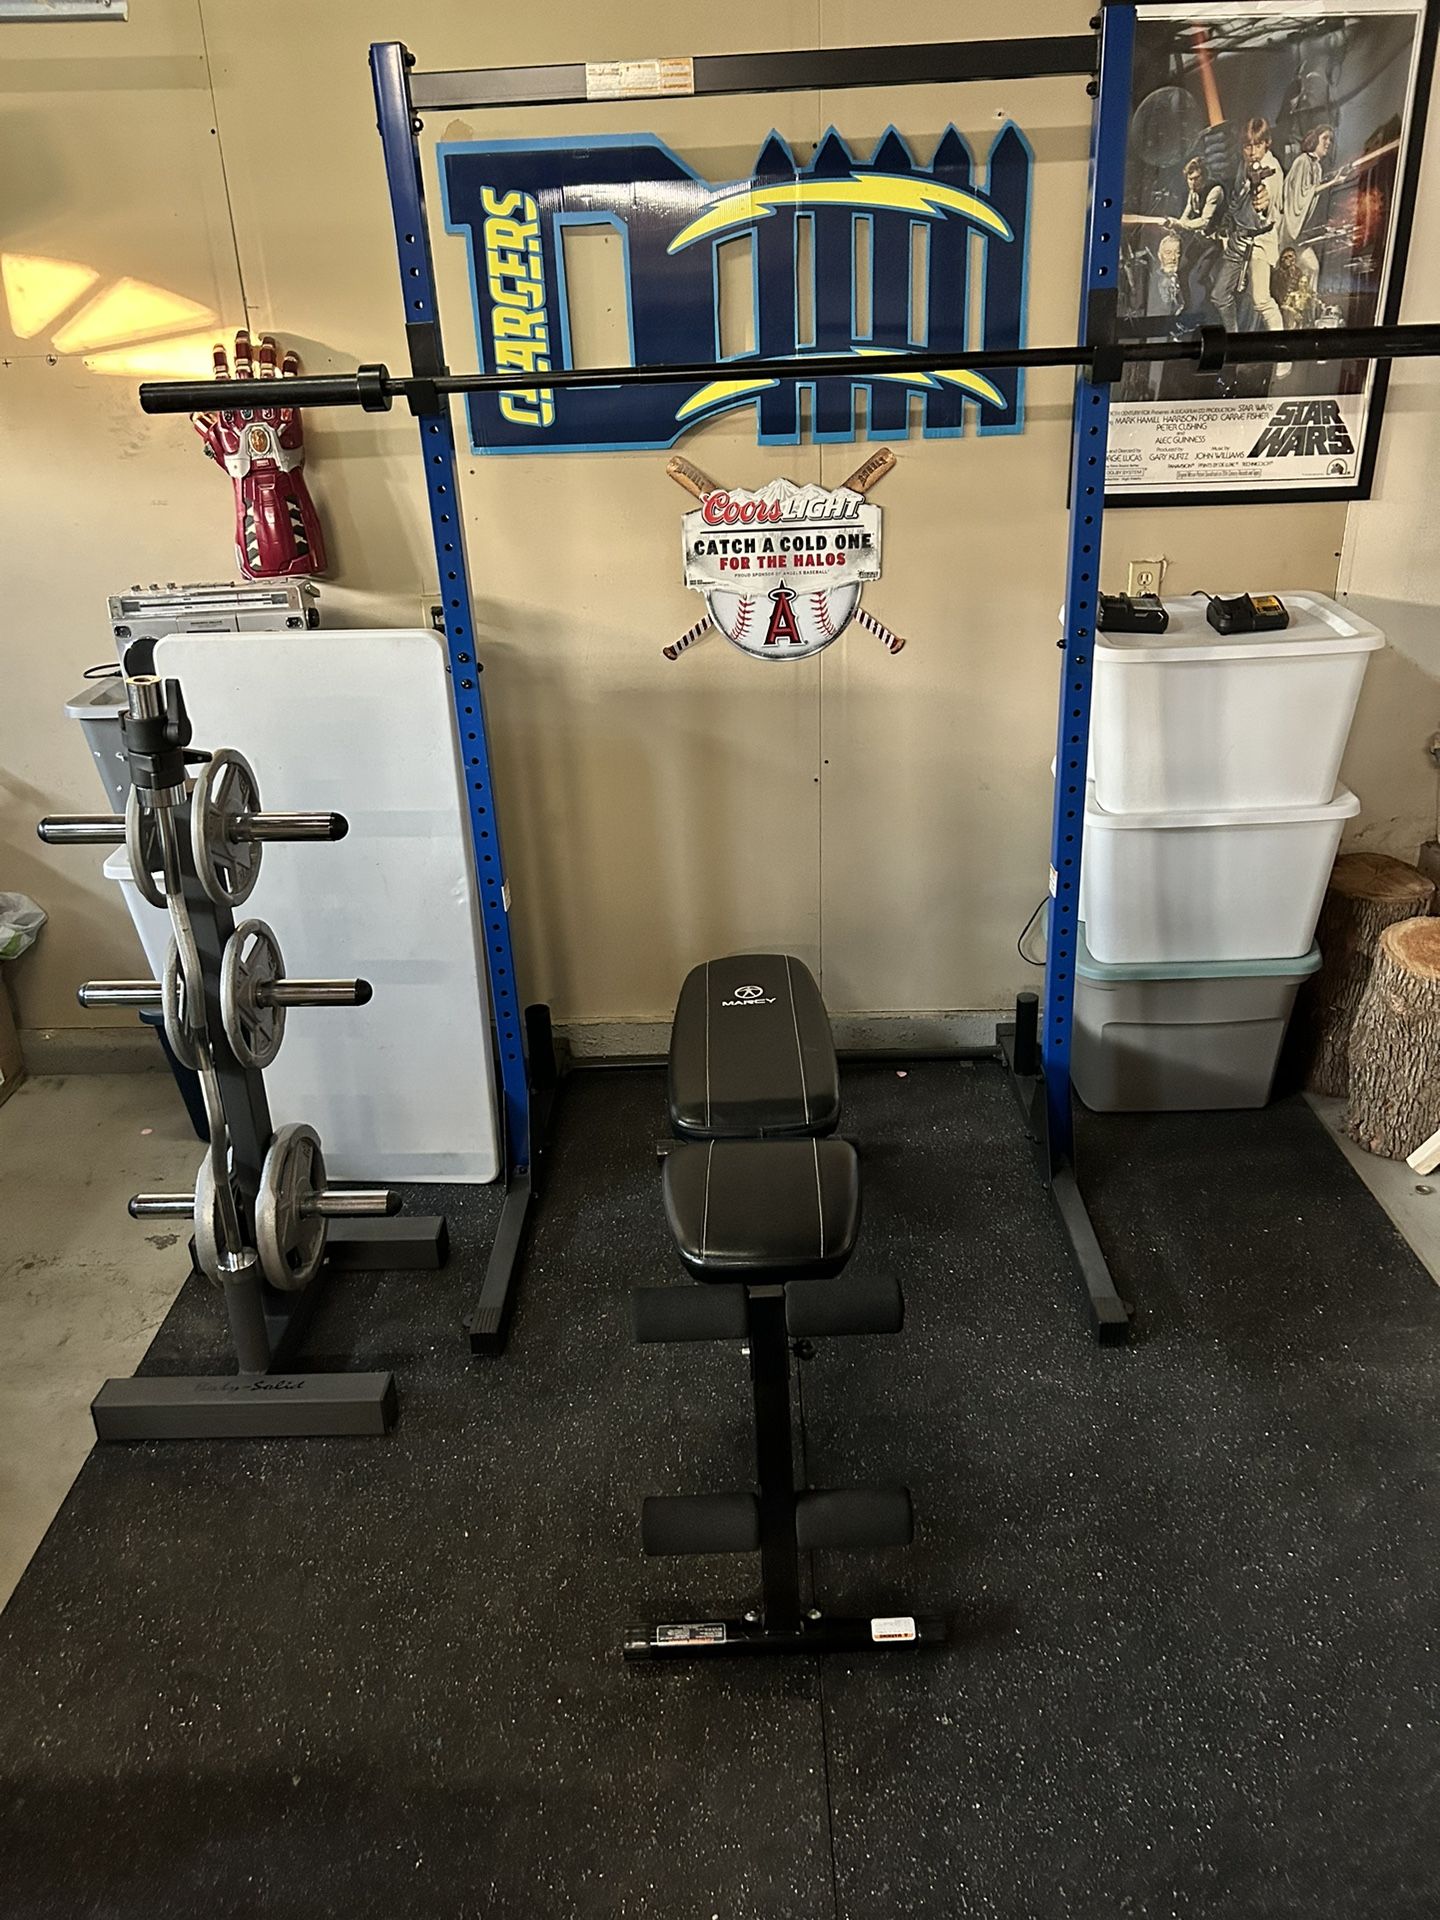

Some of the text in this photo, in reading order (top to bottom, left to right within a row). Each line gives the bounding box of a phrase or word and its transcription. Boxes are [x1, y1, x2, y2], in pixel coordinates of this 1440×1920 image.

[1239, 404, 1254, 412] STAR
[1255, 403, 1274, 411] WARS
[1199, 413, 1218, 421] FORD
[1220, 413, 1245, 421] CARRIE
[1247, 412, 1269, 420] FISHER
[1268, 400, 1345, 427] STAR
[1178, 423, 1207, 431] CUSHING
[1247, 425, 1355, 458] WARS
[1149, 453, 1168, 461] GARY
[1195, 451, 1245, 460] JOHN WILLIAMS
[701, 491, 865, 525] Coors LIGHT
[693, 533, 873, 556] CATCH A COLD ONE
[719, 552, 846, 571] FOR THE HALOS
[721, 997, 777, 1007] MARCY
